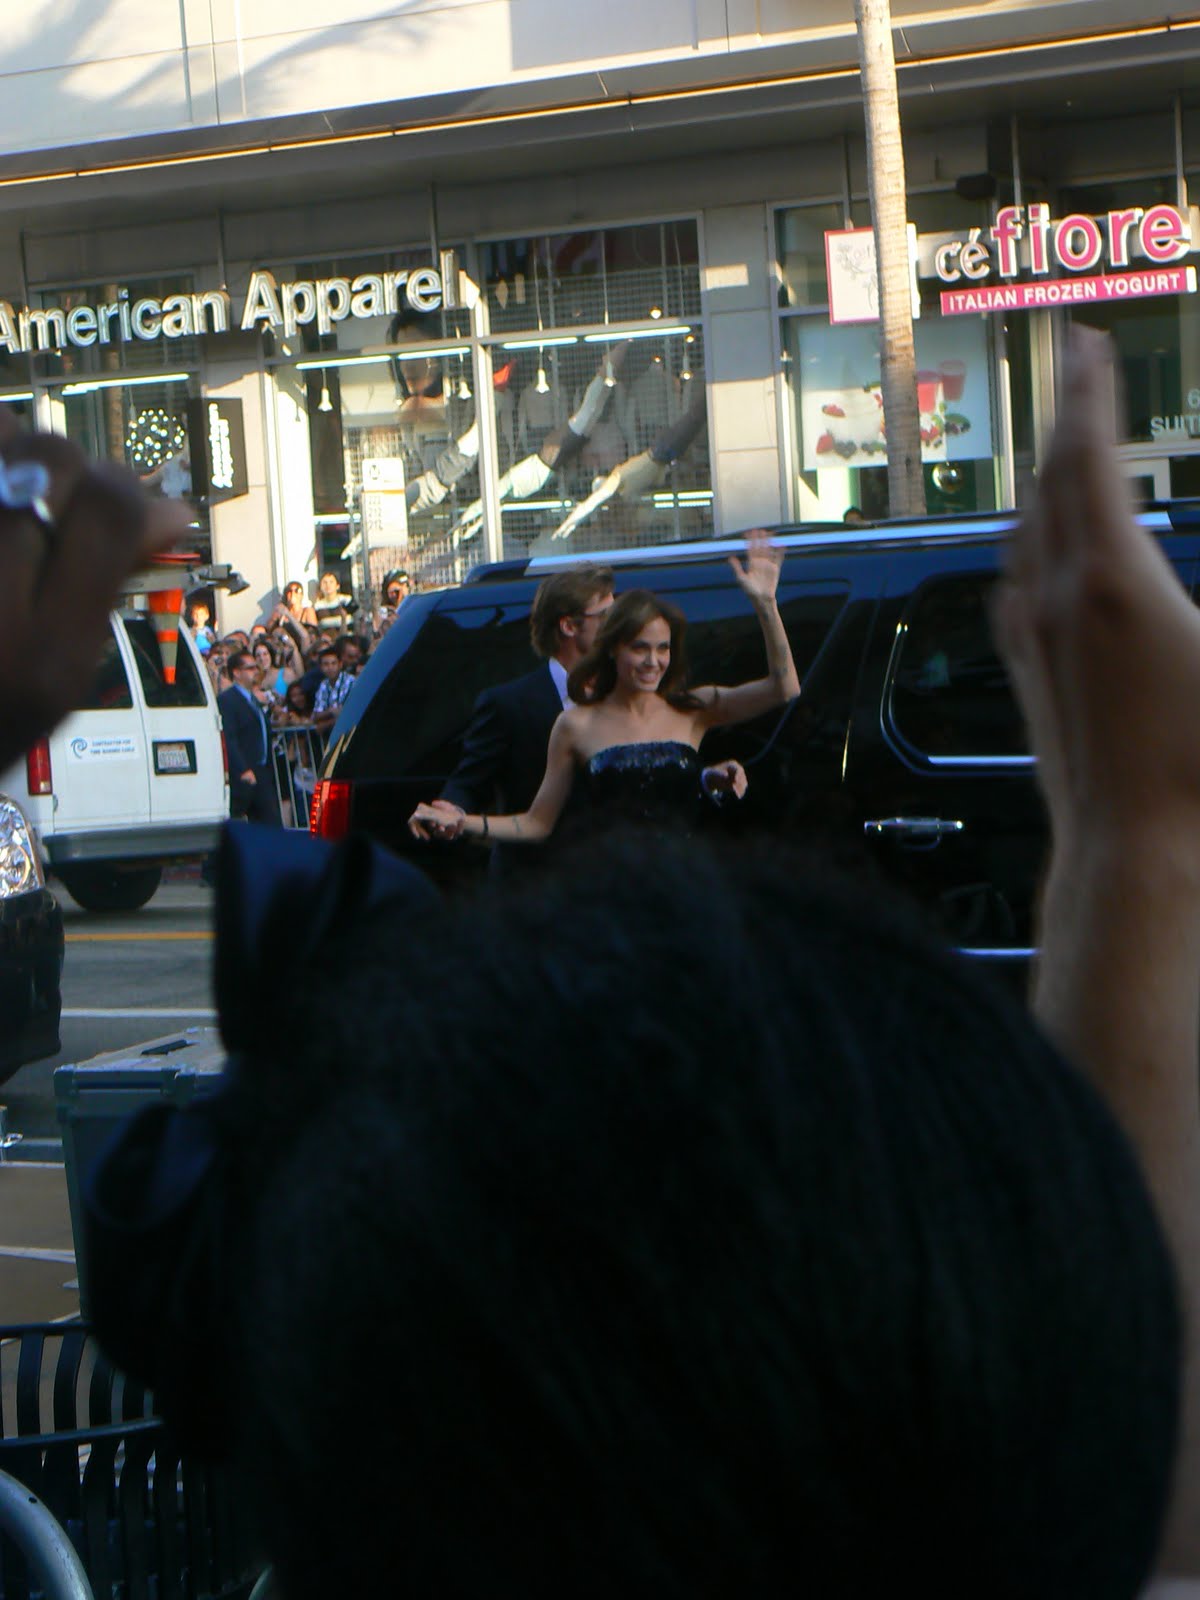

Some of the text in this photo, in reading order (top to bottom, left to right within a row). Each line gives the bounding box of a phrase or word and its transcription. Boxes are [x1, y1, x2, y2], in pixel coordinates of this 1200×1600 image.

[990, 203, 1193, 278] fiore
[240, 249, 460, 338] Apparel
[949, 272, 1182, 312] ITALIAN FROZEN YOGURT
[1150, 415, 1200, 434] SUIT
